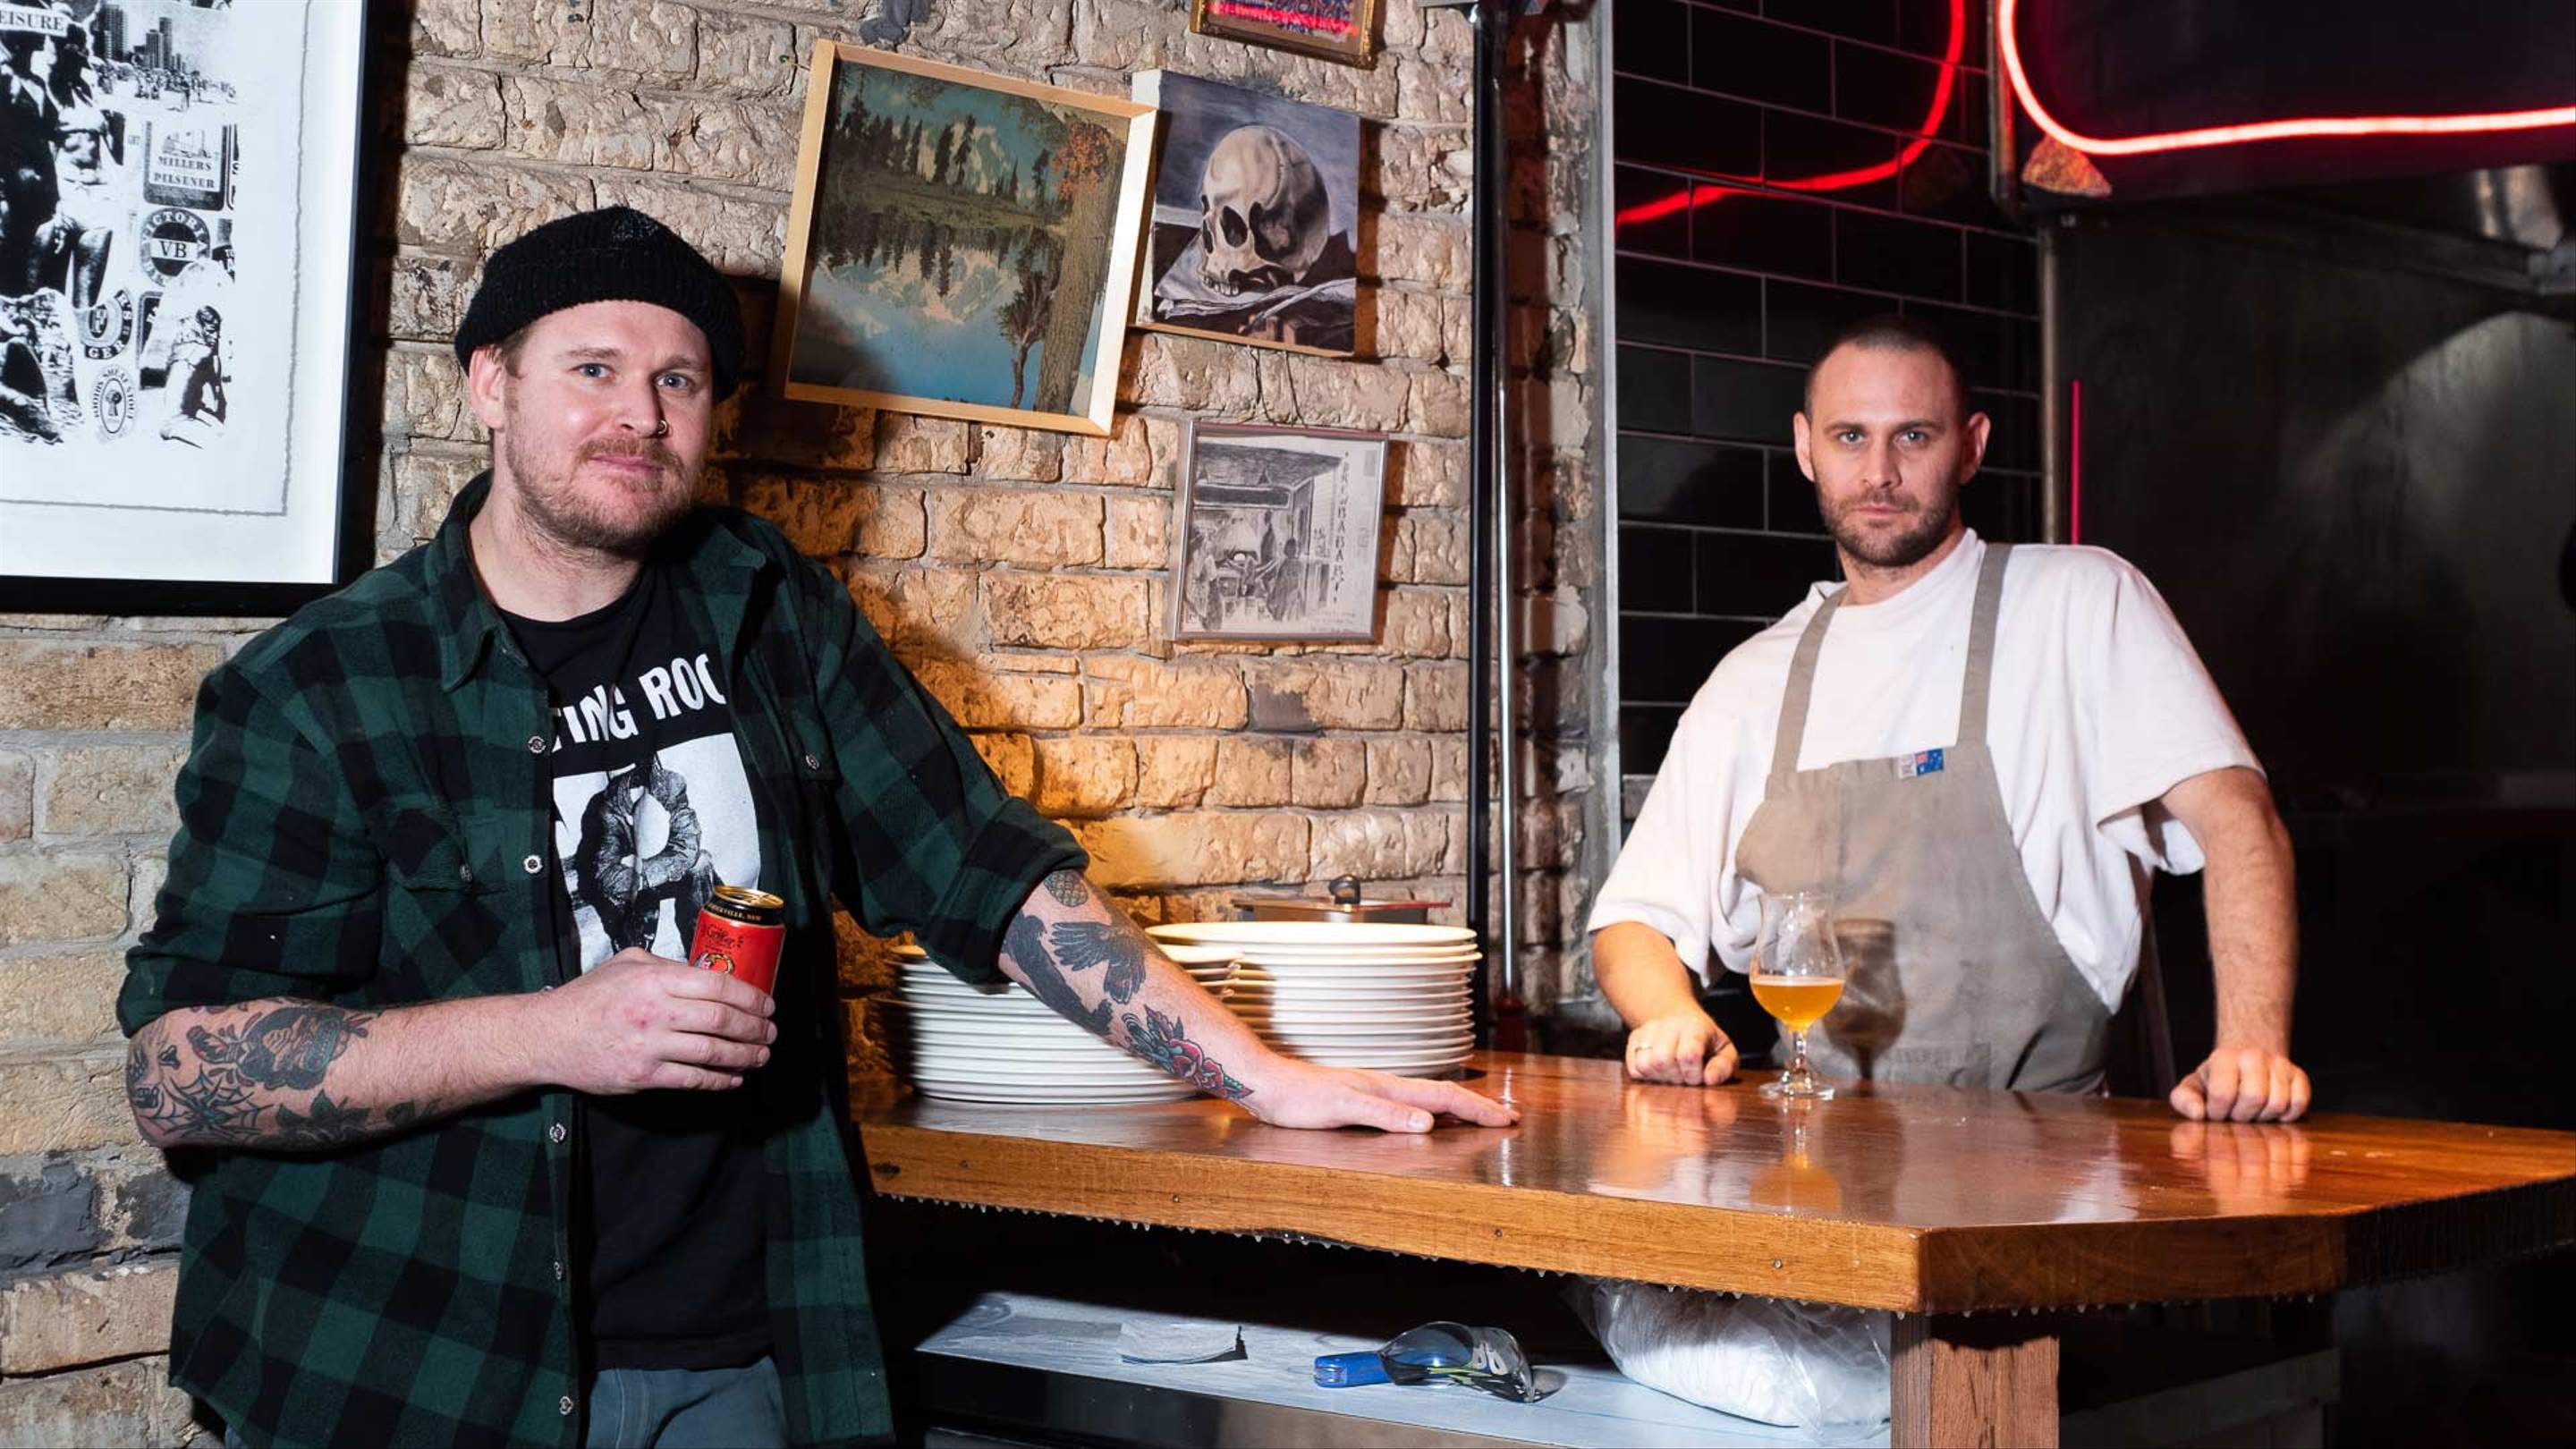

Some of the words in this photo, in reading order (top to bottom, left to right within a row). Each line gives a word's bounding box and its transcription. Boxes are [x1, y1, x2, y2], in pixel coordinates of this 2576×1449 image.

[158, 156, 212, 171] MILLERS
[153, 173, 215, 189] PILSENER
[142, 211, 209, 258] VICTORIA
[159, 240, 187, 258] VB
[551, 683, 639, 753] ING
